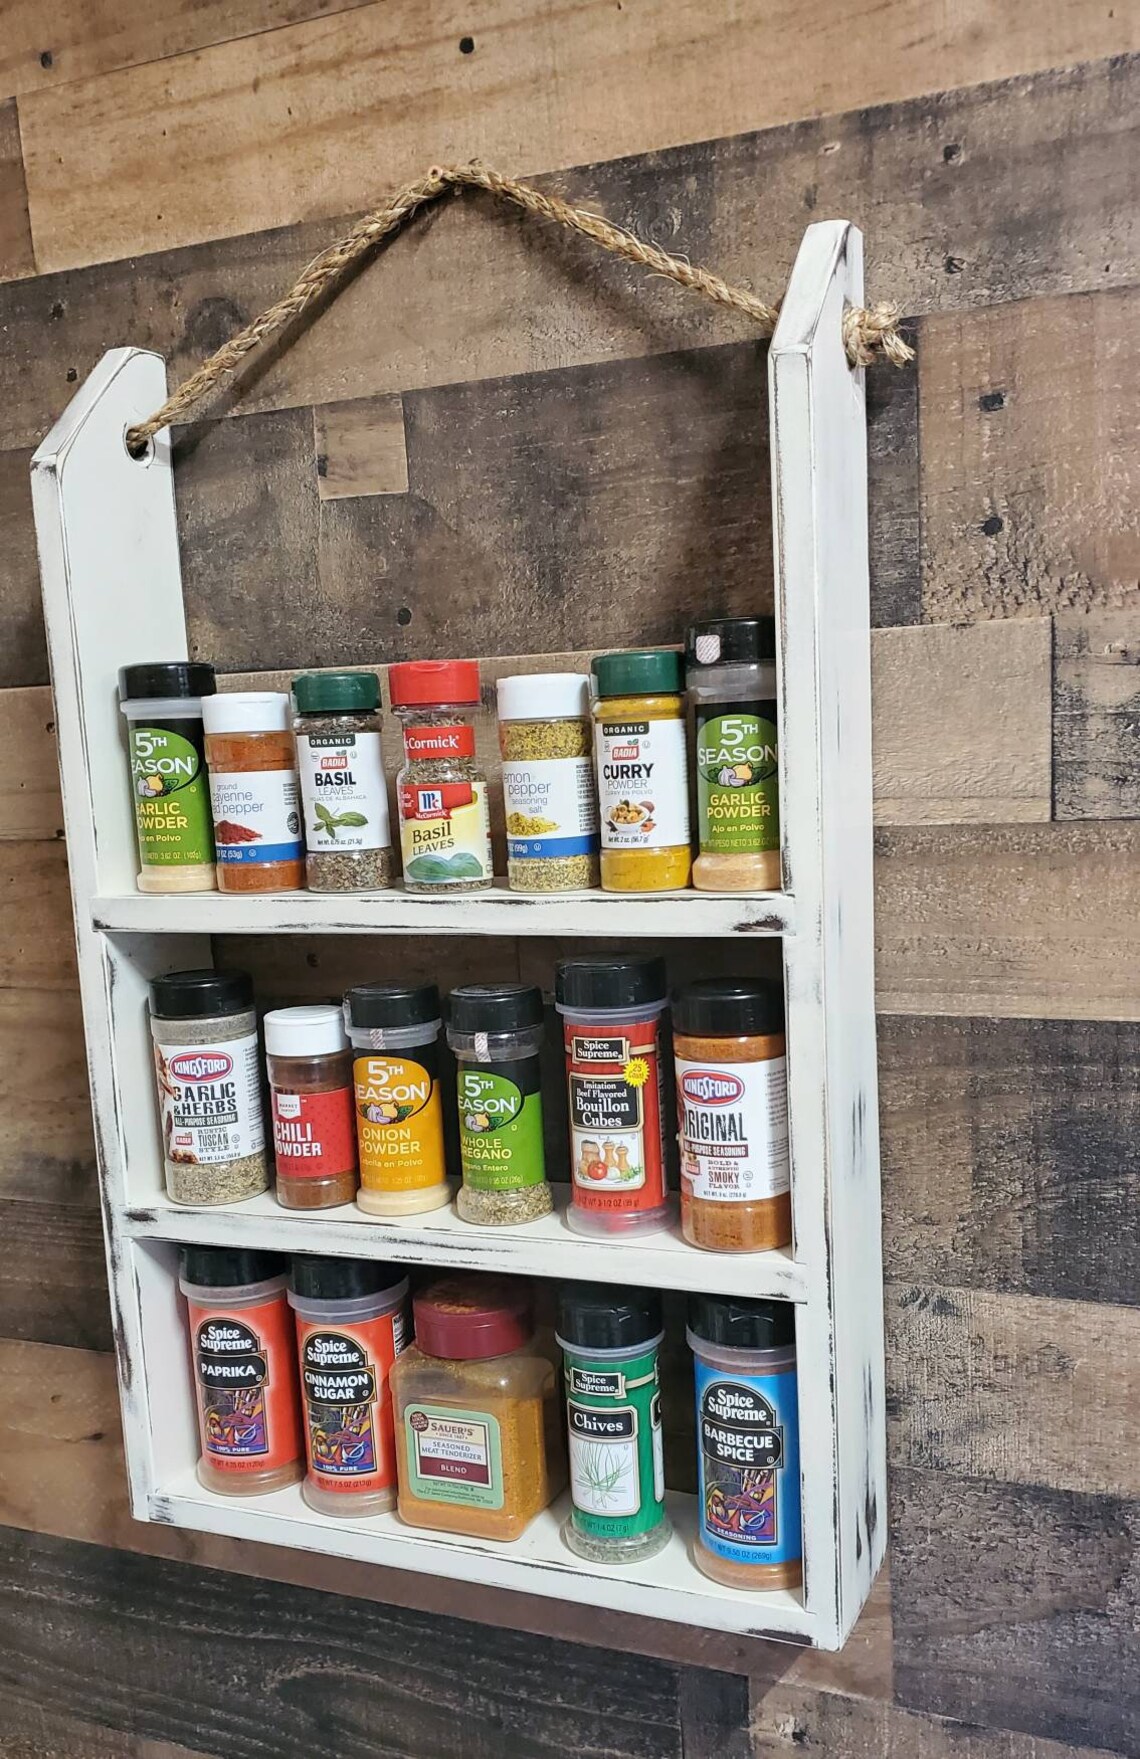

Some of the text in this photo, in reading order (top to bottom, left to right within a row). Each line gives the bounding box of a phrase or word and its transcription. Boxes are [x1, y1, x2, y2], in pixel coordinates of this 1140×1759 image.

[603, 725, 645, 734] ORGANIC
[719, 719, 759, 746] 5TH
[135, 732, 167, 757] 5TH
[310, 738, 352, 746] ORGANIC
[613, 748, 638, 759] BADIA
[697, 743, 778, 767] SEASON
[131, 757, 193, 775] EASON
[322, 758, 346, 768] BADIA
[315, 771, 357, 787] BASIL
[504, 772, 531, 784] emon
[603, 763, 654, 780] CURRY
[216, 783, 238, 792] ground
[318, 786, 355, 796] LEAVES
[508, 782, 551, 797] pepper
[607, 779, 648, 790] POWDER
[512, 796, 548, 806] seasoning
[710, 792, 765, 806] GARLIC
[222, 802, 264, 816] pepper
[529, 805, 542, 813] salt
[707, 804, 771, 819] POWDER
[137, 816, 188, 829] OWDER
[712, 825, 725, 834] Ajo
[740, 824, 764, 832] Polvo
[156, 834, 181, 842] Polvo
[412, 821, 452, 844] Basil
[413, 838, 455, 856] LEAVES
[577, 1048, 619, 1059] Supreme
[583, 1040, 610, 1052] Spice
[174, 1057, 228, 1079] KINGSFORD
[367, 1060, 404, 1086] 5TH
[632, 1064, 642, 1073] 25
[172, 1082, 236, 1102] GARLIC
[464, 1075, 494, 1098] 5TH
[583, 1080, 617, 1090] Imitation
[684, 1076, 738, 1100] KINGSFORD
[576, 1088, 627, 1099] Beef Flavored
[181, 1098, 237, 1115] HERBS
[458, 1097, 516, 1114] EASON
[576, 1096, 630, 1113] Bouillon
[582, 1111, 622, 1127] Cubes
[275, 1120, 312, 1142] CHILI
[362, 1127, 411, 1141] ONION
[198, 1133, 229, 1148] TUSCAN
[360, 1139, 421, 1155] POWDER
[276, 1140, 322, 1157] OWDER
[462, 1145, 512, 1160] REGANO
[713, 1146, 746, 1157] SEASONING
[397, 1159, 423, 1167] Polvo
[708, 1171, 740, 1184] SMOKY
[207, 1326, 240, 1340] Spice
[200, 1335, 252, 1351] Supreme
[313, 1338, 347, 1353] Spice
[306, 1347, 360, 1366] Supreme
[201, 1363, 256, 1378] PAPRIKA
[304, 1371, 368, 1388] CINNAMON
[575, 1378, 615, 1392] Supreme
[581, 1372, 606, 1385] Spice
[314, 1388, 355, 1400] SUGAR
[717, 1388, 754, 1408] Spice
[707, 1398, 767, 1422] Supreme
[431, 1422, 474, 1436] SAUER'S
[574, 1412, 624, 1432] Chives
[703, 1423, 773, 1449] BARBECUE
[421, 1446, 482, 1461] MEAT TENDERIZER
[432, 1440, 471, 1453] SEASONED
[716, 1444, 754, 1462] SPICE
[440, 1464, 467, 1474] BLEND
[717, 1527, 757, 1541] SEASONING
[742, 1550, 751, 1559] OZ
